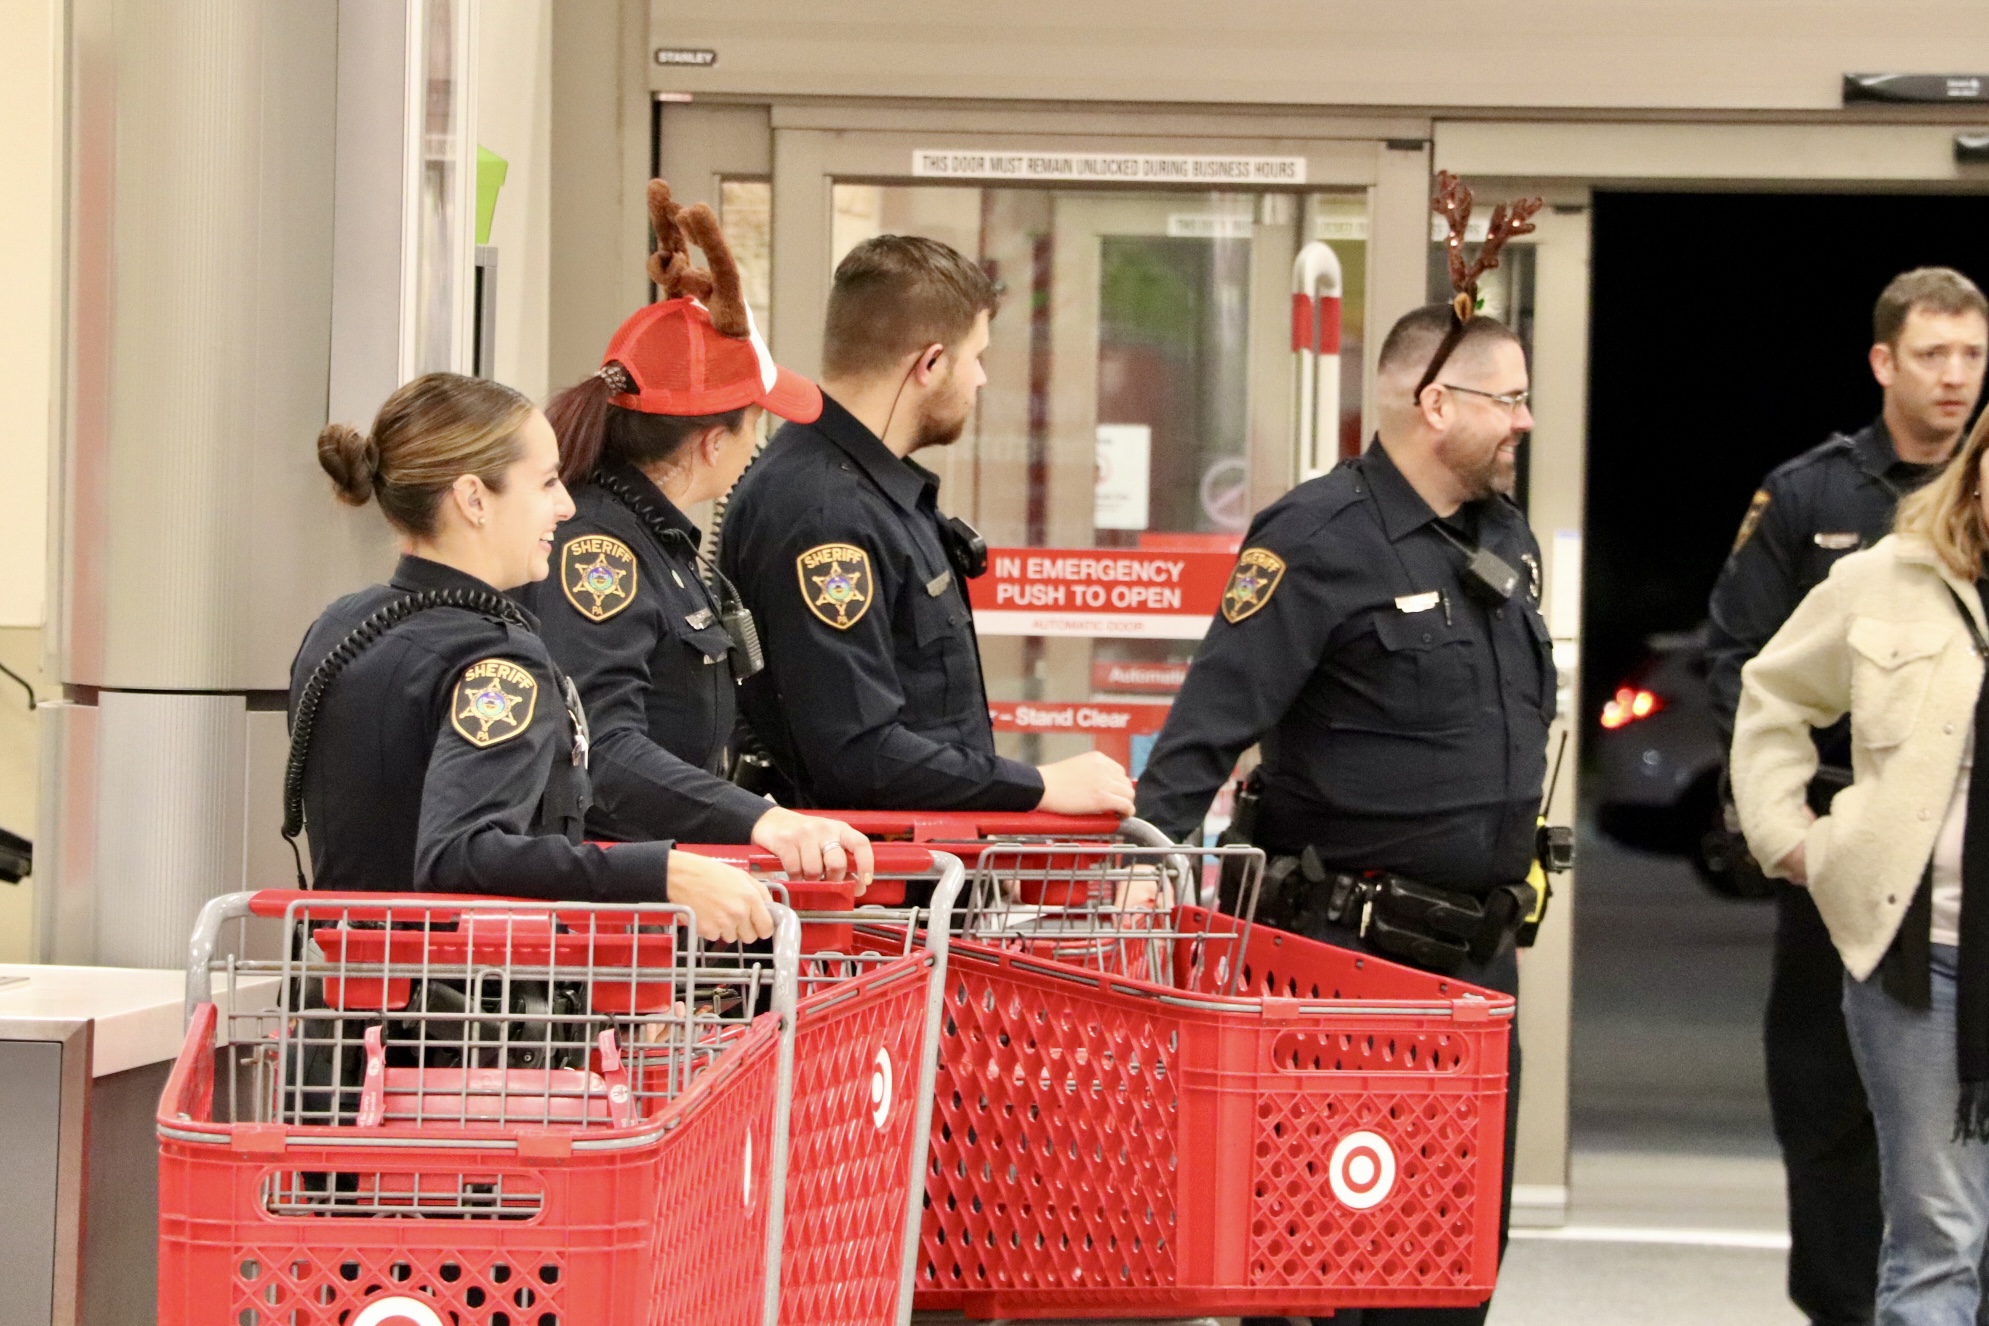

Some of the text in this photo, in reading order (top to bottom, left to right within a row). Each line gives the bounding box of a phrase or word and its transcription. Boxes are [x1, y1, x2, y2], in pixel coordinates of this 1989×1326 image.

[658, 51, 714, 64] STANLEY
[923, 155, 1296, 179] THIS DOOR MUST REMAIN UNLOCKED DURING BUSINESS HOURS
[571, 539, 632, 563] SHERIFF
[803, 547, 862, 569] SHERIFF
[994, 556, 1185, 582] IN EMERGENCY
[996, 583, 1182, 609] PUSH TO OPEN
[591, 605, 604, 615] PA
[1032, 620, 1105, 631] AUTOMATIC
[464, 663, 533, 689] SHERIFF
[1108, 667, 1186, 685] Automati
[1015, 705, 1075, 726] Stand
[1076, 708, 1131, 728] Clear
[476, 731, 489, 741] PA
